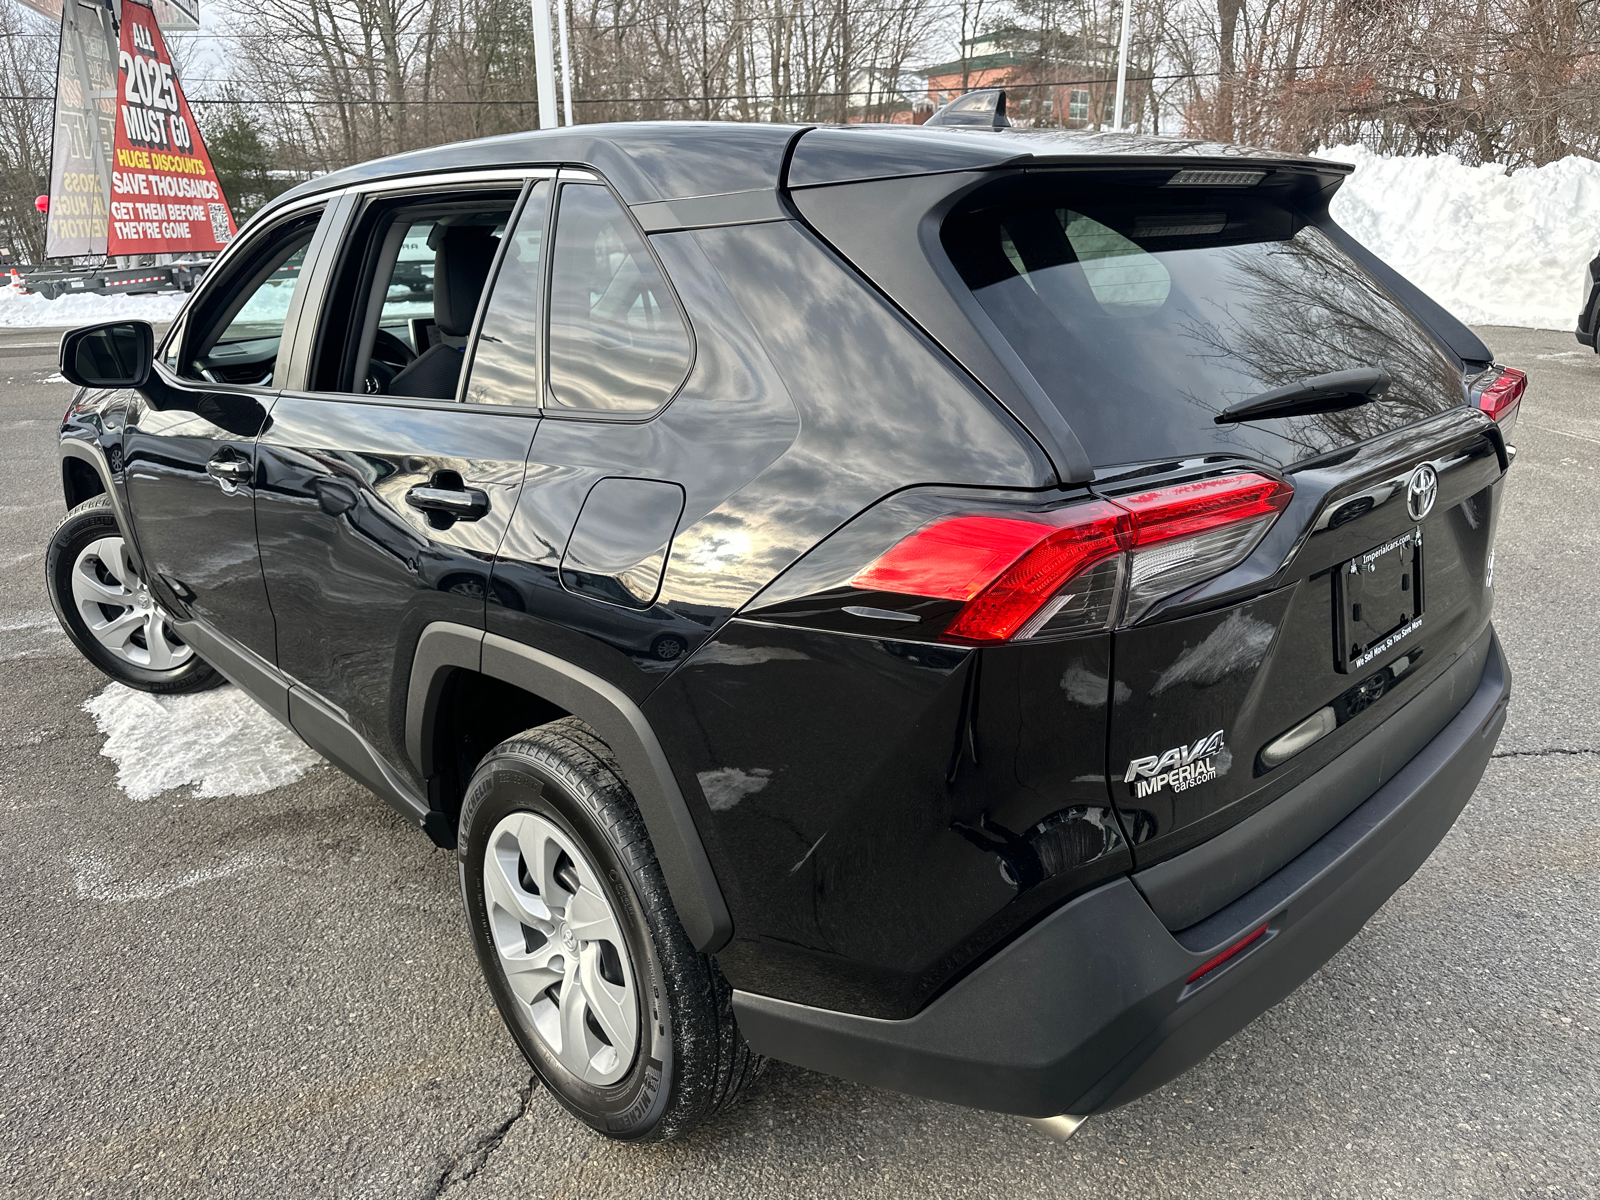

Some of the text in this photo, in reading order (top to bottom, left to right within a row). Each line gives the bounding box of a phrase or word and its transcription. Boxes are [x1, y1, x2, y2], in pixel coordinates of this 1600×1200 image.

[132, 22, 155, 51] ALL
[119, 50, 178, 112] 2025
[121, 104, 191, 149] MUST GO
[116, 149, 206, 176] HUGE DISCOUNTS
[112, 171, 219, 200] SAVE THOUSANDS
[111, 201, 207, 221] GET THEM BEFORE
[114, 221, 192, 239] THEY'RE GONE
[1362, 534, 1411, 564] Imperialcars.com
[1355, 657, 1365, 668] We
[1364, 650, 1374, 663] Sell
[1386, 638, 1393, 648] So
[1392, 632, 1402, 643] You
[1401, 626, 1412, 638] Save
[1411, 618, 1423, 631] More
[1124, 729, 1225, 783] RAV4
[1136, 757, 1216, 798] IMPERIAL
[1174, 770, 1216, 793] cars.com
[462, 776, 494, 833] MICHELIN
[605, 1090, 652, 1132] MICHELIN
